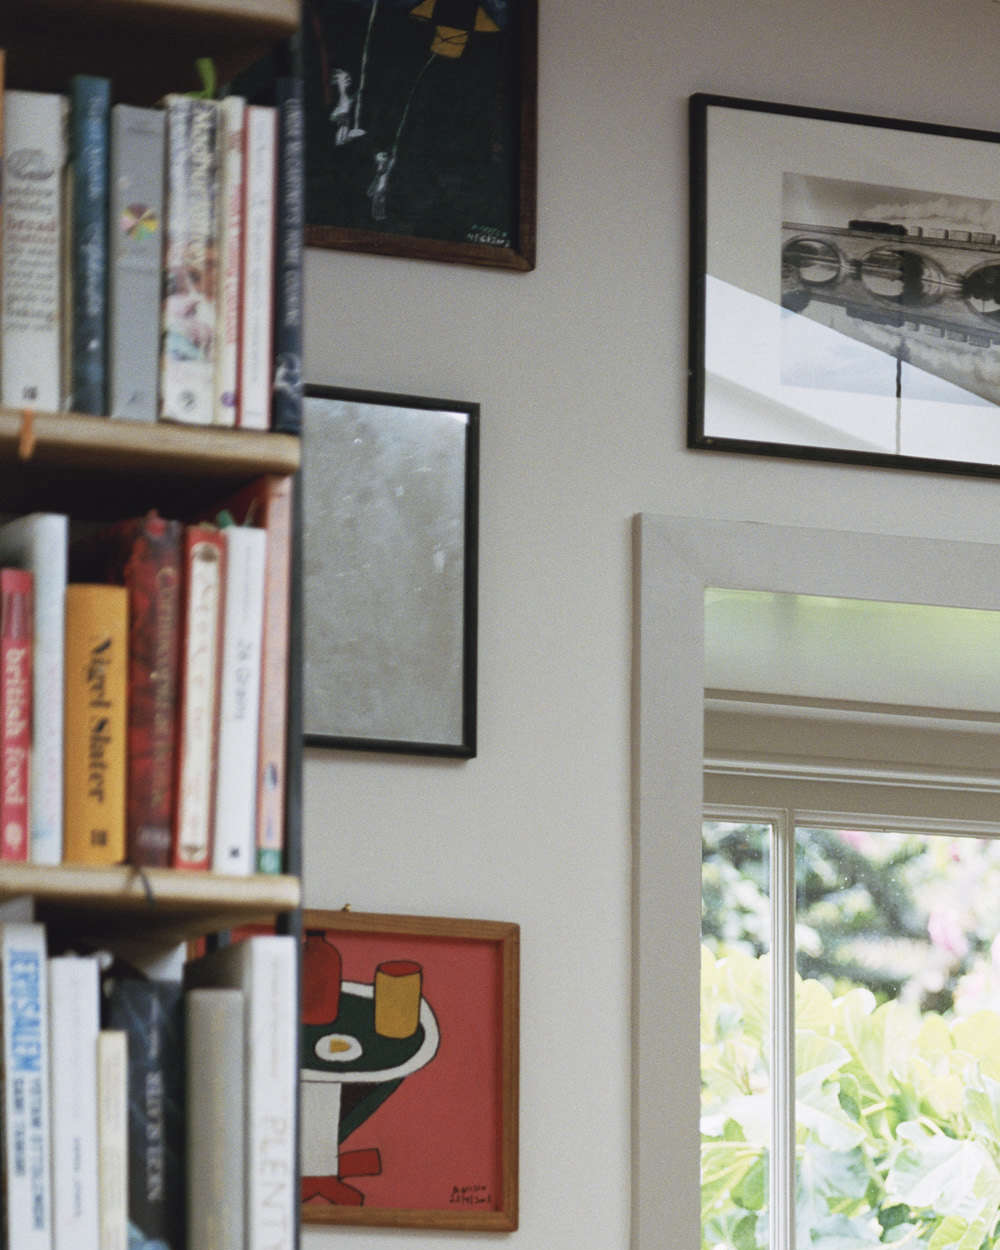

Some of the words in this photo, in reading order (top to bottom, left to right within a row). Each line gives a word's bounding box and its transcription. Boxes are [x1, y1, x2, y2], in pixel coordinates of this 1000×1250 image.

[7, 214, 56, 232] bread
[5, 648, 26, 737] british
[85, 638, 112, 707] Nigel
[5, 747, 25, 805] food
[88, 717, 110, 803] Slater
[9, 949, 41, 1071] JERUSALEM
[14, 1078, 25, 1112] SAMI
[30, 1078, 42, 1127] YOTAM
